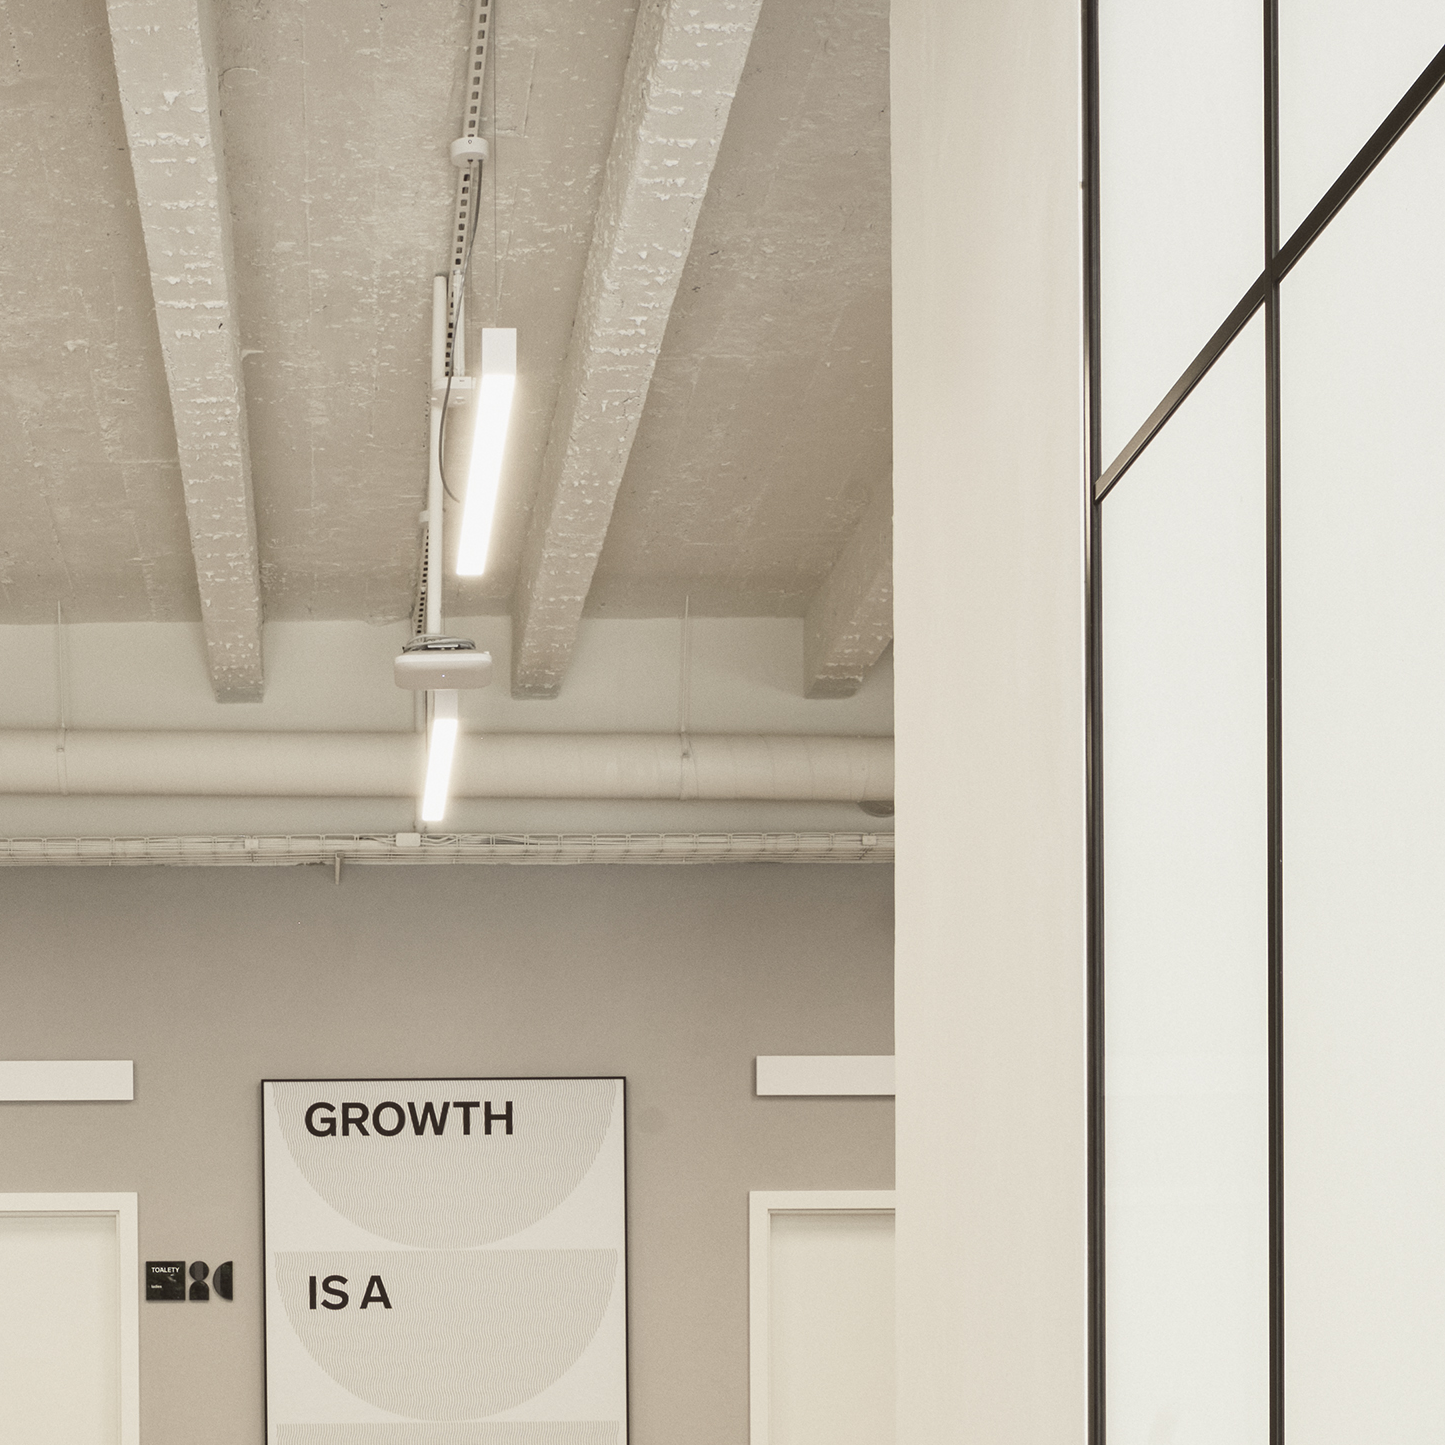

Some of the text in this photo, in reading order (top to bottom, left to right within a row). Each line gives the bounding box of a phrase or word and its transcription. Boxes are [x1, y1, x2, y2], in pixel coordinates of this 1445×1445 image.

[304, 1101, 513, 1137] GROWTH
[309, 1275, 393, 1310] IS A
